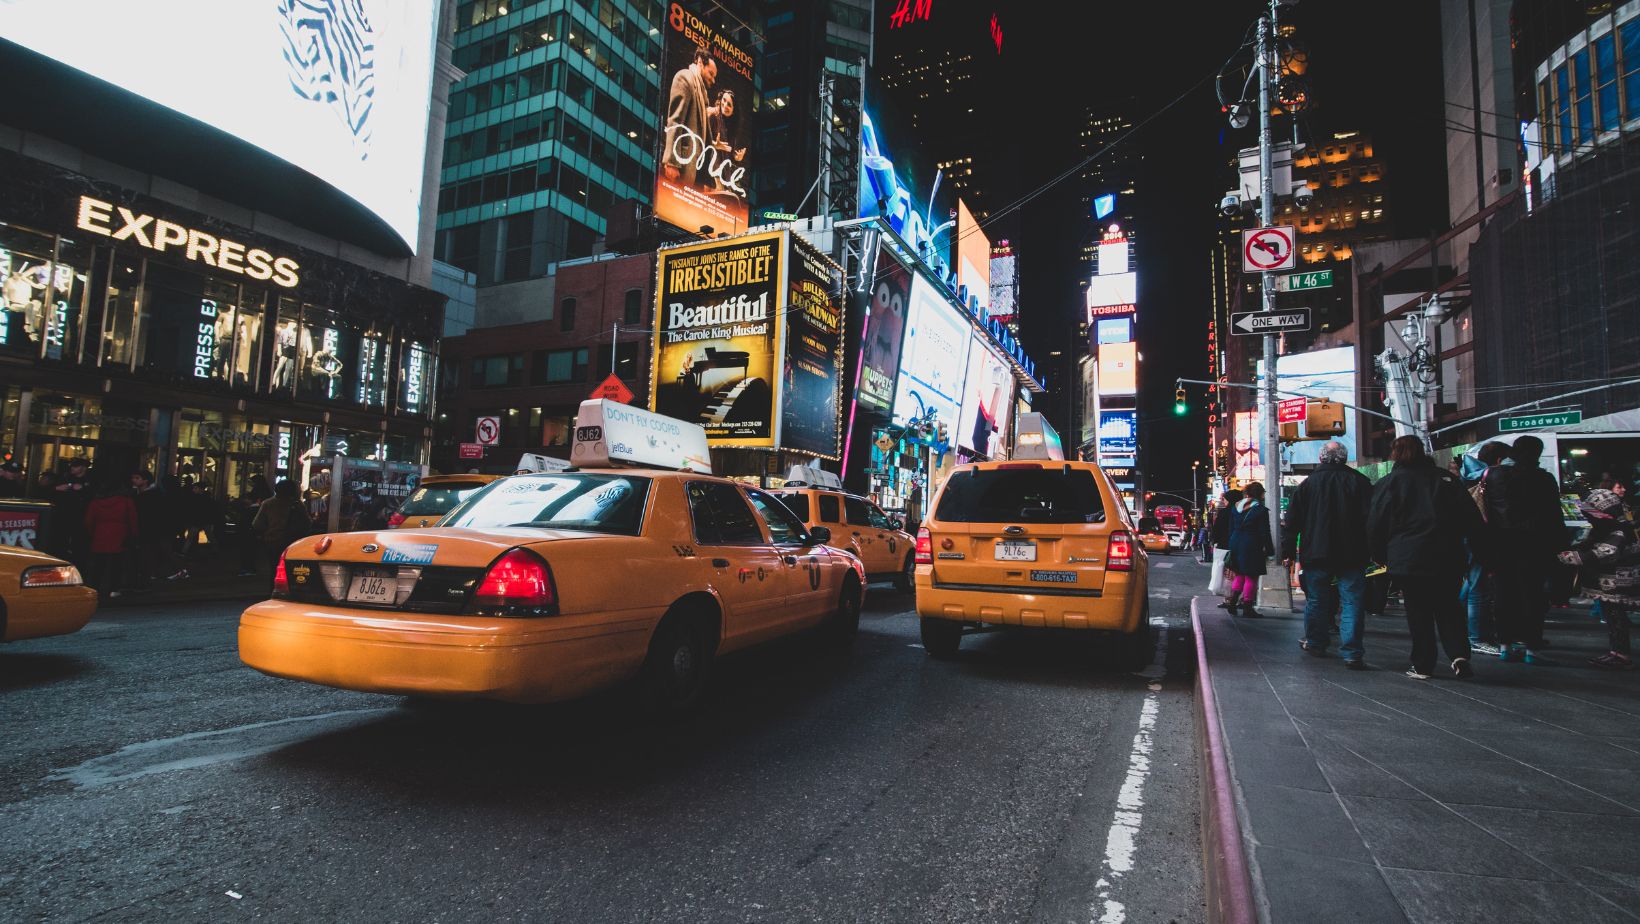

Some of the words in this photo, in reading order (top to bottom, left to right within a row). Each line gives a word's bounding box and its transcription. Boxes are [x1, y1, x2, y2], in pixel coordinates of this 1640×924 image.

[670, 2, 684, 32] 8
[890, 0, 932, 29] H&M
[685, 11, 713, 39] TONY
[714, 34, 753, 68] AWARDS
[685, 26, 711, 49] BEST
[713, 46, 752, 81] MUSICAL
[77, 195, 299, 288] EXPRESS
[1100, 238, 1127, 246] TOSHIBA
[700, 253, 717, 265] JOINS
[717, 252, 728, 263] THE
[729, 249, 749, 261] RANKS
[750, 247, 758, 257] OF
[758, 245, 771, 256] THE
[1292, 276, 1300, 288] W
[1304, 274, 1317, 286] 46
[803, 281, 829, 306] BULLETS
[668, 291, 768, 329] Beautiful
[792, 290, 838, 329] BROADWAY
[1092, 304, 1136, 316] TOSHIBA
[1252, 318, 1273, 327] ONE
[1279, 315, 1301, 325] WAY
[668, 332, 683, 343] The
[683, 327, 710, 341] Carole
[711, 328, 732, 340] King
[732, 323, 767, 336] Musical
[1207, 321, 1215, 374] ERNST
[864, 366, 893, 391] MUPPETS
[1208, 384, 1216, 392] &
[607, 407, 634, 425] DON'T
[636, 416, 648, 428] FLY
[650, 418, 680, 436] COOPED
[1511, 417, 1568, 428] Broadway
[578, 428, 600, 441] 8J62
[611, 441, 633, 455] jetBlue
[5, 519, 36, 528] SEASONS
